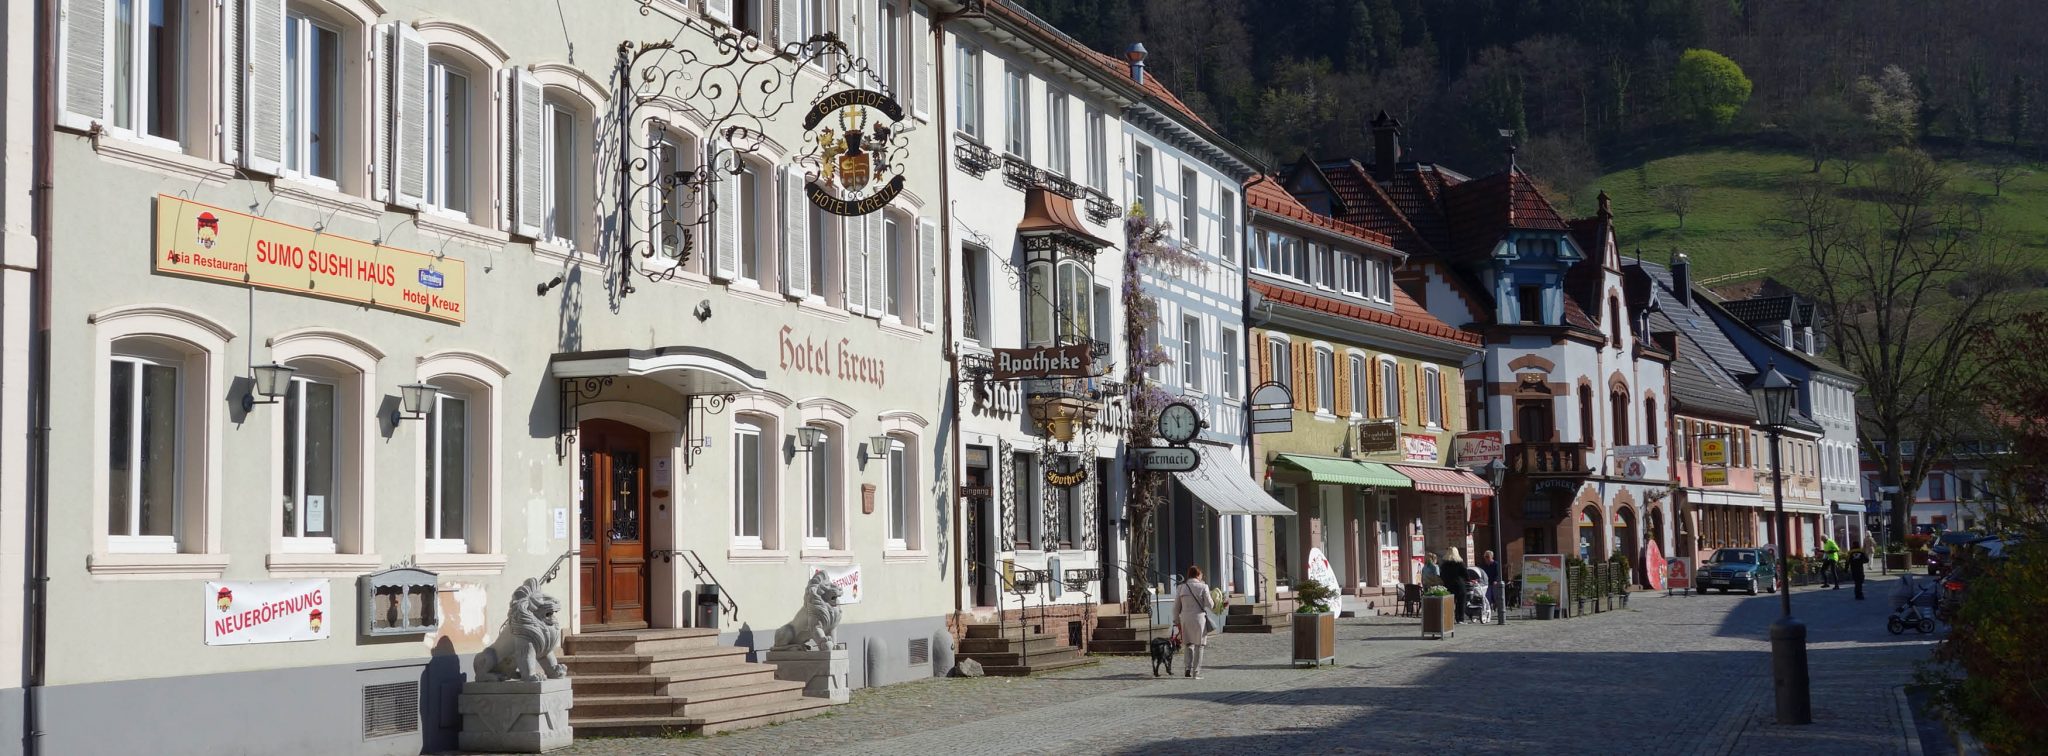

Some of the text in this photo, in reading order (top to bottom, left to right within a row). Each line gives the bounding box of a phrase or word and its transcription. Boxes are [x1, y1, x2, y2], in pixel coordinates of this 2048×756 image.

[819, 90, 887, 115] GASTHOF
[812, 183, 898, 215] HOTEL KREUZ
[167, 249, 248, 273] Asia Restaurant
[256, 240, 395, 287] SUMO SUSHI HAUS
[403, 289, 460, 313] Hotel Kreuz
[779, 324, 885, 390] Hotel Kreuz
[998, 350, 1081, 374] Apotheke
[1475, 440, 1500, 455] Baba
[962, 487, 989, 497] Eingang
[214, 589, 323, 637] NEUERÖFFNUNG
